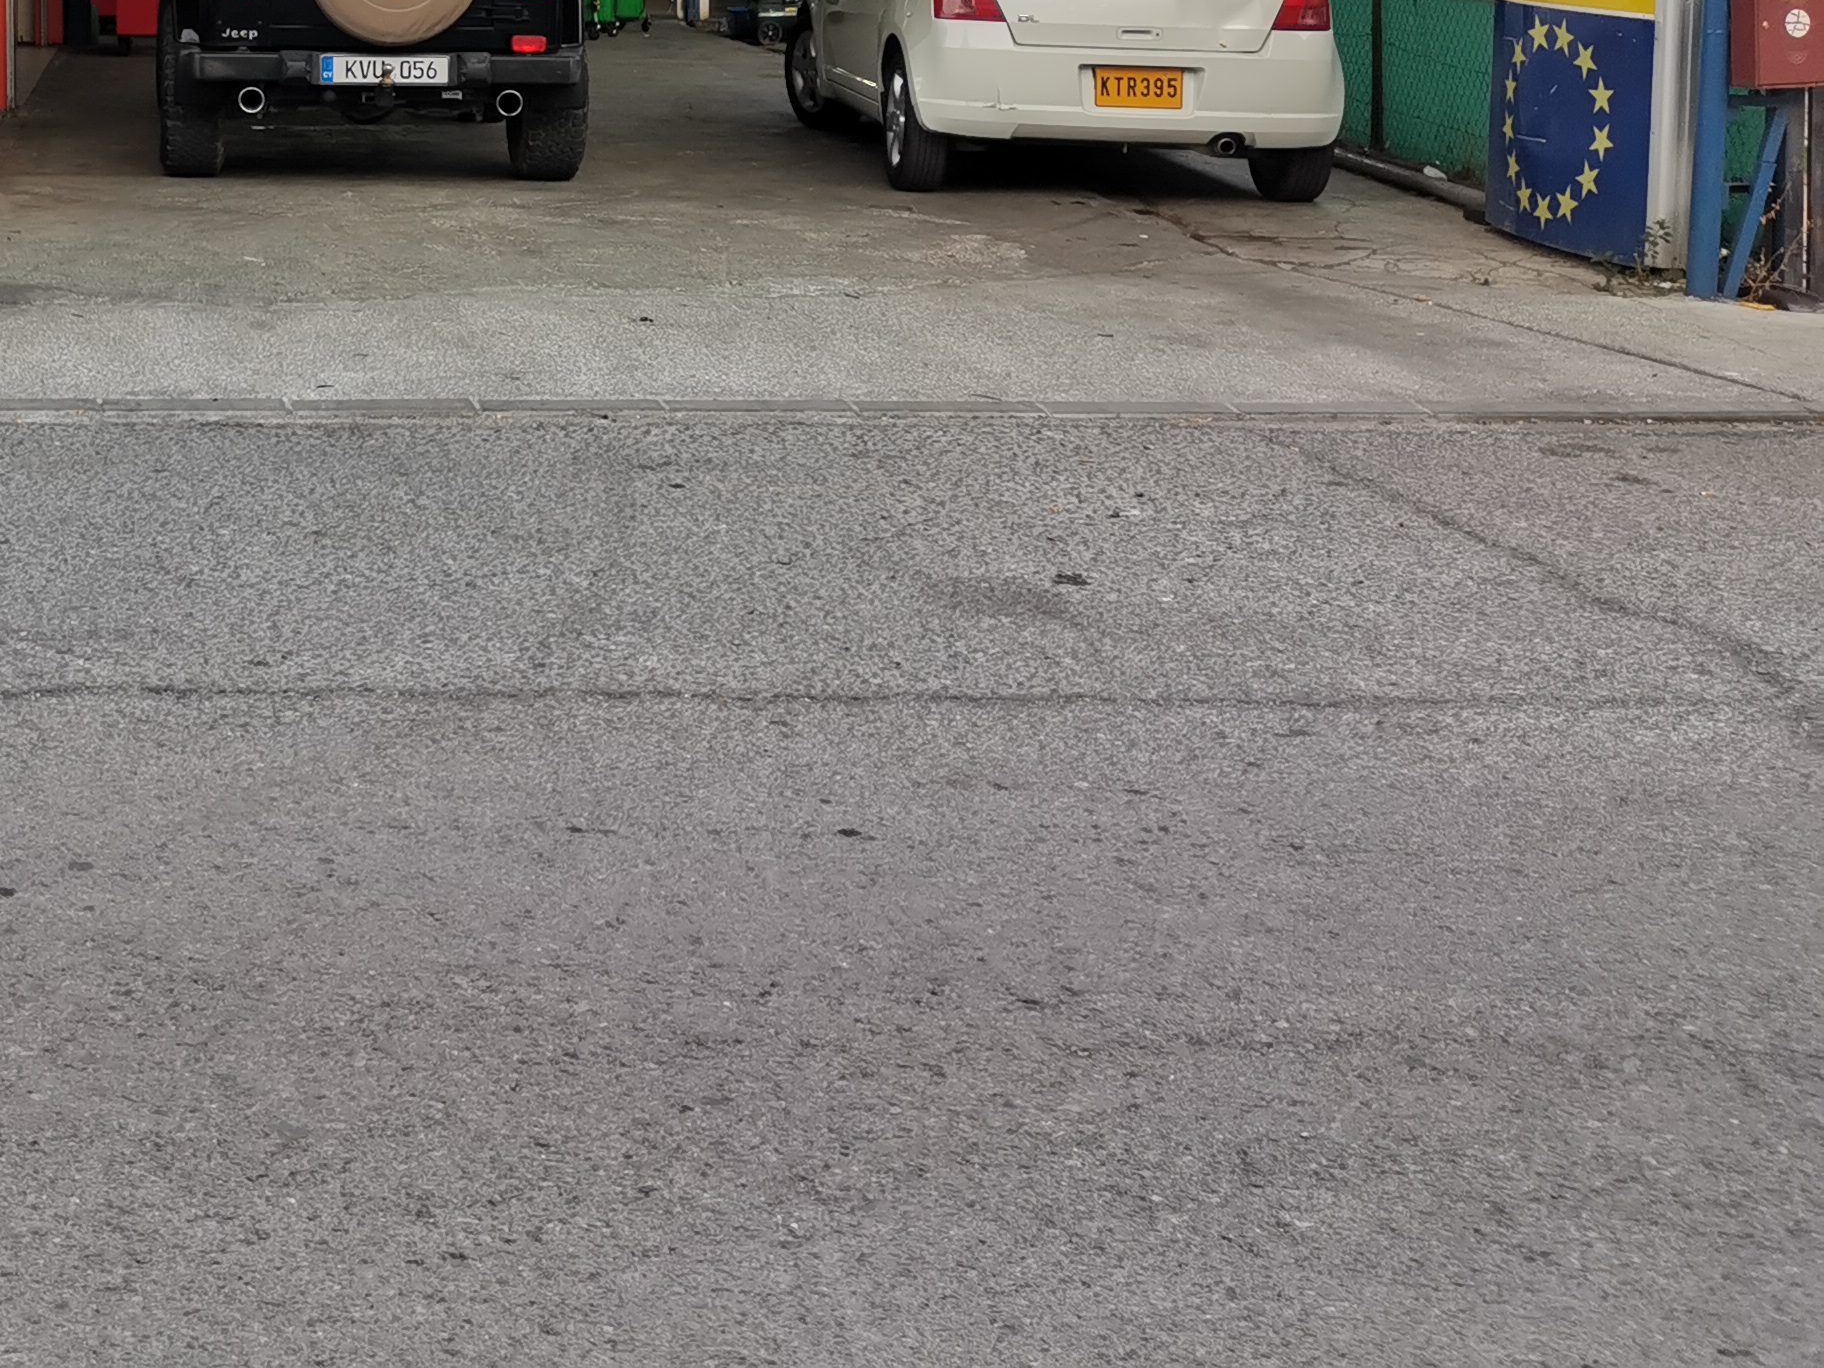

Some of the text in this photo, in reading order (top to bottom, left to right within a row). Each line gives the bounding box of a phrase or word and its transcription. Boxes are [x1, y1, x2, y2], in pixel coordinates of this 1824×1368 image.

[221, 27, 258, 40] Jeep
[345, 60, 385, 79] KVU
[400, 60, 438, 80] 056
[1100, 76, 1178, 99] KTR395
